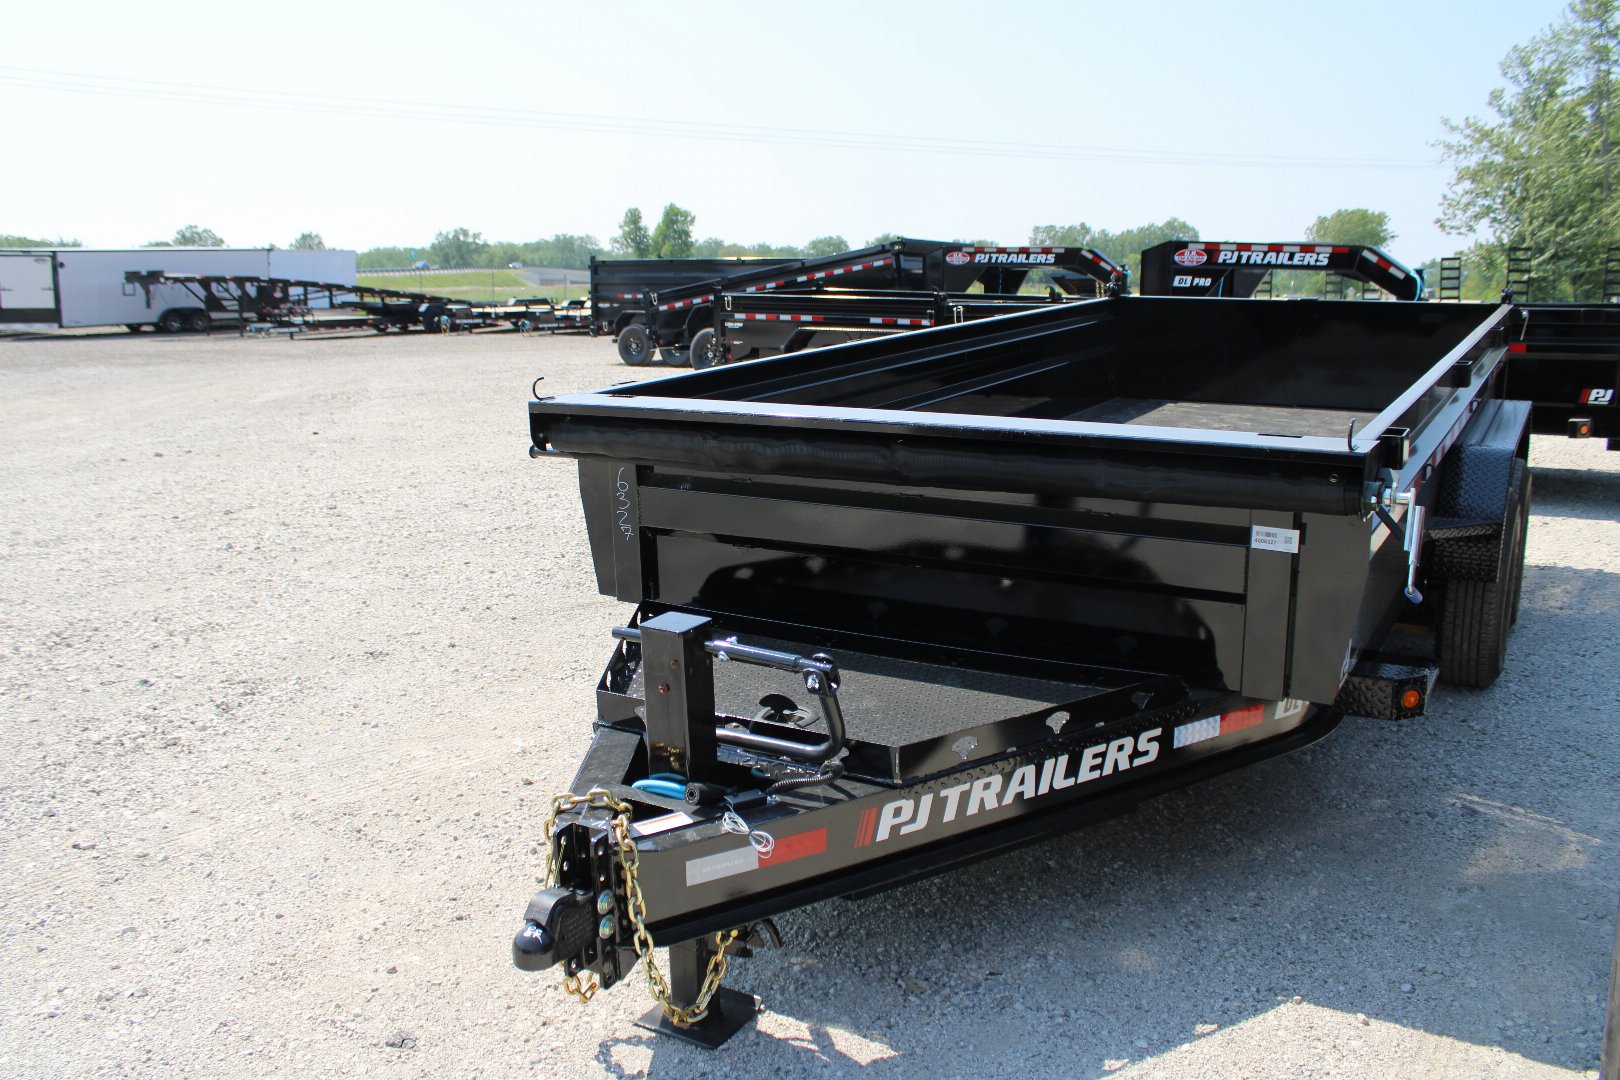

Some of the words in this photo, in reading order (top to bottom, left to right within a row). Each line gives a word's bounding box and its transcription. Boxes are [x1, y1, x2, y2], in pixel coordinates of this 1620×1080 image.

[1239, 252, 1330, 266] TRAILERS
[1192, 277, 1212, 287] PRO
[1588, 388, 1614, 402] PJ
[616, 467, 634, 540] 6327
[940, 728, 1162, 824] TRAILERS
